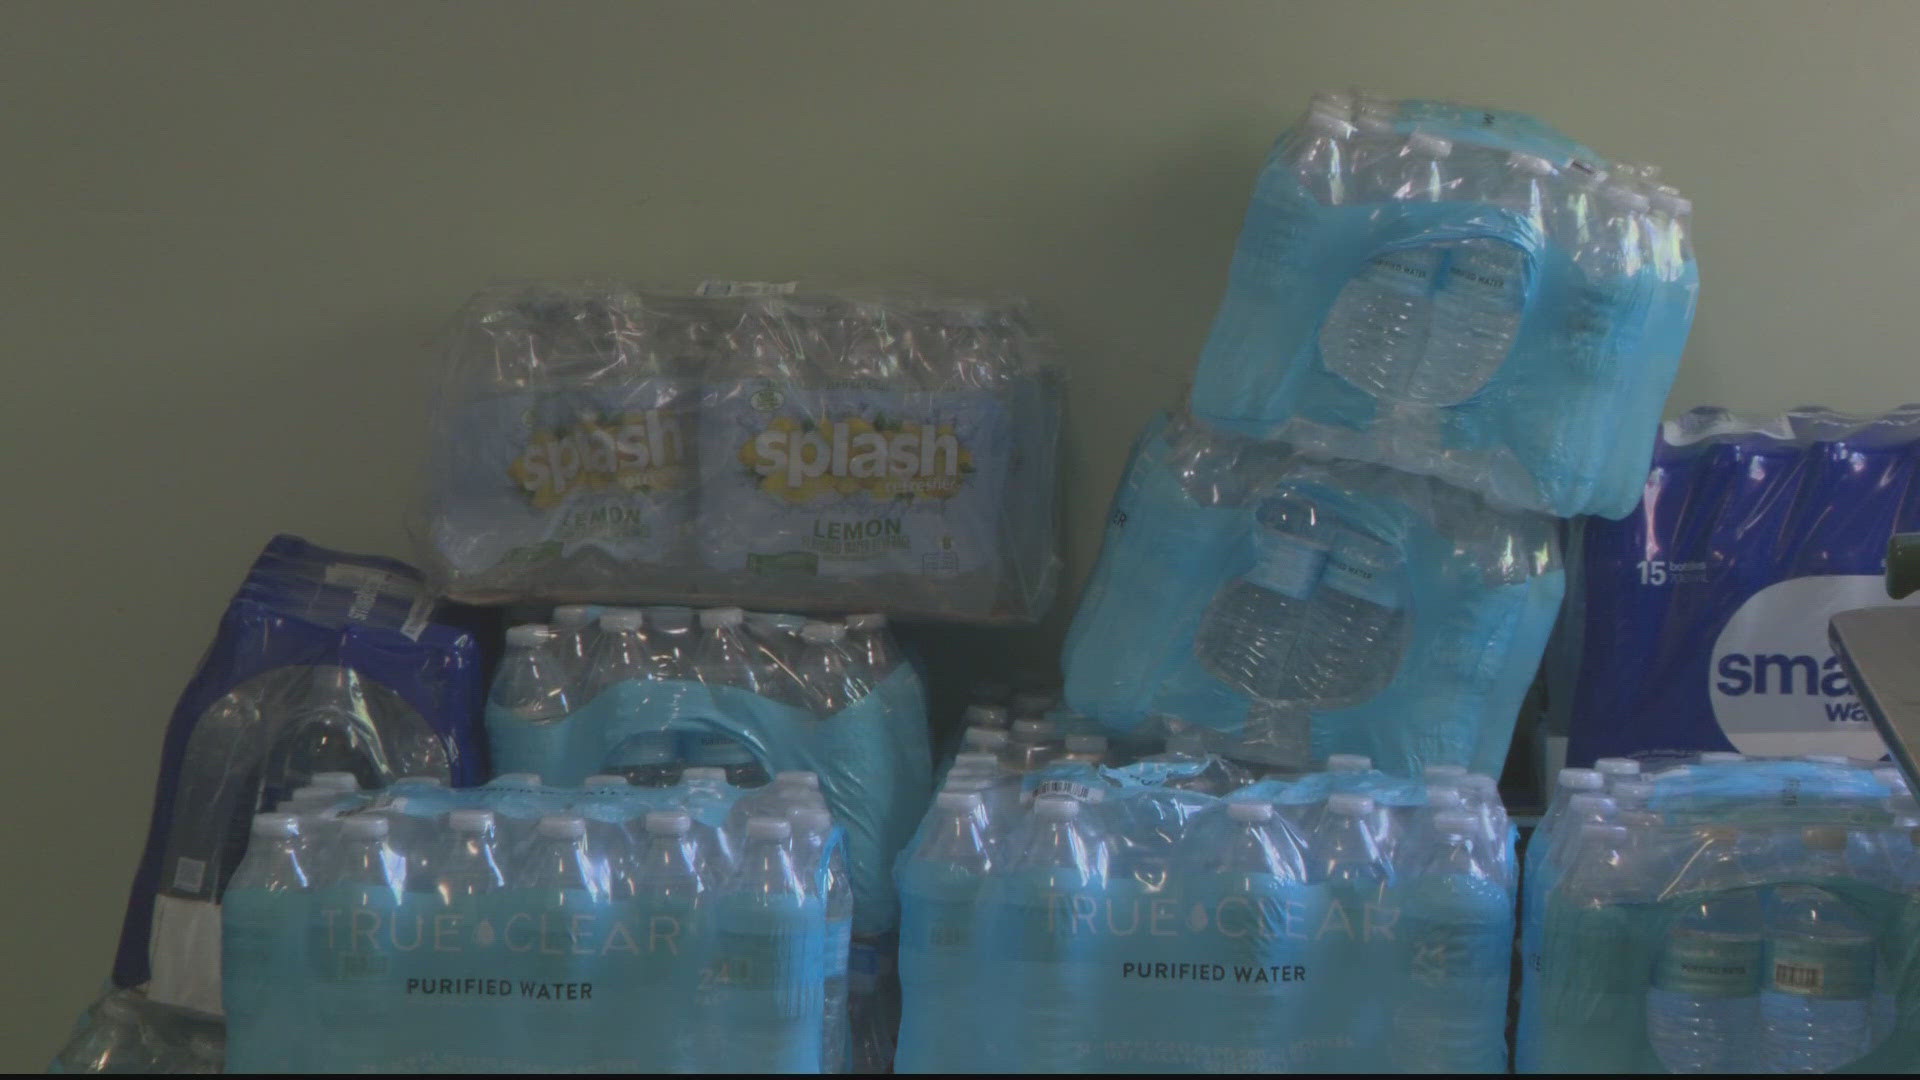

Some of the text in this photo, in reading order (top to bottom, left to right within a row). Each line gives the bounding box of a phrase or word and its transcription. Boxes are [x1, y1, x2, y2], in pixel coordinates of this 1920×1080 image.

[523, 407, 683, 494] splash
[754, 421, 959, 488] splash
[812, 517, 902, 541] LEMON
[1636, 560, 1666, 586] 15
[1716, 652, 1854, 698] sma
[1824, 702, 1871, 723] wa
[320, 907, 682, 956] TRUE CLEAR
[1041, 892, 1401, 943] TRUE CLEAR
[405, 976, 593, 1001] PURIFIED WATER
[1122, 961, 1307, 984] PURIFIED WATER
